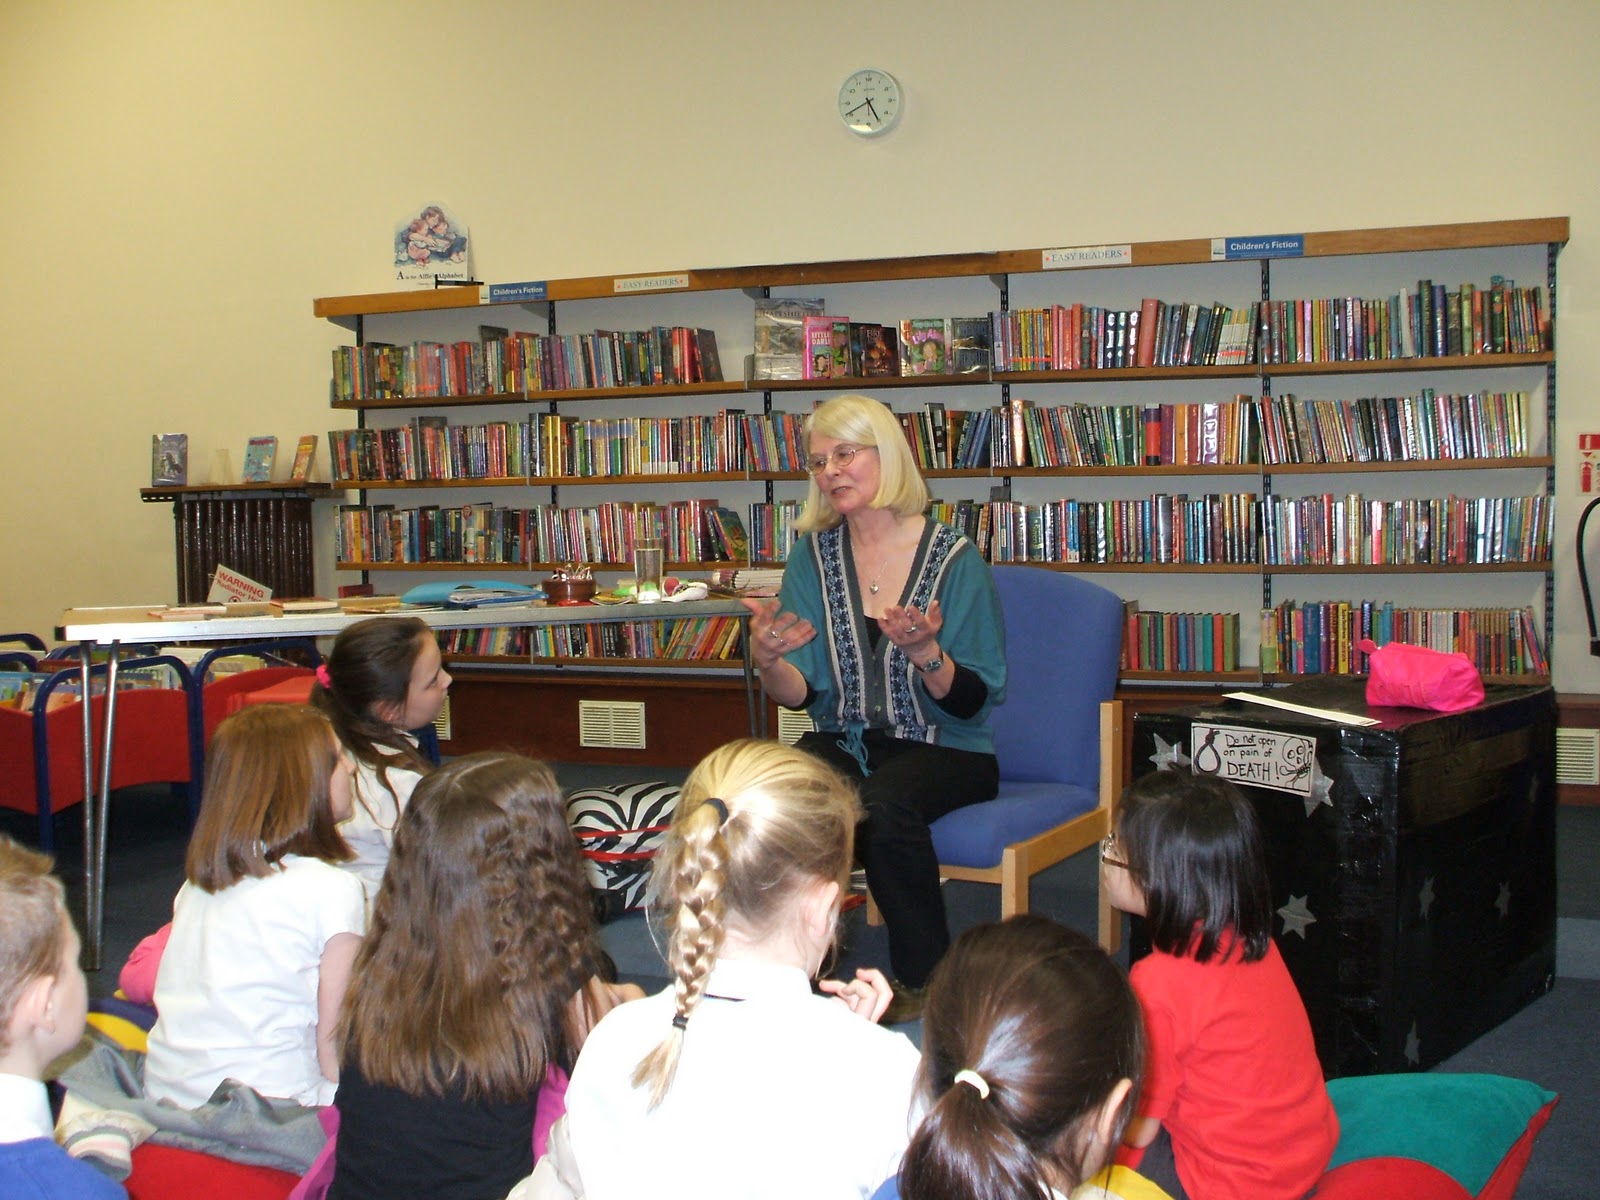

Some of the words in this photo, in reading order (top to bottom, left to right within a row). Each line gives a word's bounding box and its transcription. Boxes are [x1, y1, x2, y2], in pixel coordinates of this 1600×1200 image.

[1230, 242, 1269, 251] Children's
[1271, 241, 1298, 249] Fiction
[1051, 251, 1077, 263] EASY
[1078, 249, 1122, 261] READERS
[396, 271, 404, 280] A
[623, 279, 643, 290] EASY
[644, 277, 679, 289] READERS
[493, 287, 522, 296] Children's
[523, 286, 543, 294] Fiction
[217, 579, 246, 597] Radiator
[218, 571, 264, 598] WARNING
[1225, 734, 1240, 748] Do
[1243, 733, 1256, 744] not
[1258, 737, 1276, 749] open
[1223, 749, 1236, 757] on
[1240, 747, 1260, 760] pain
[1263, 749, 1273, 758] of
